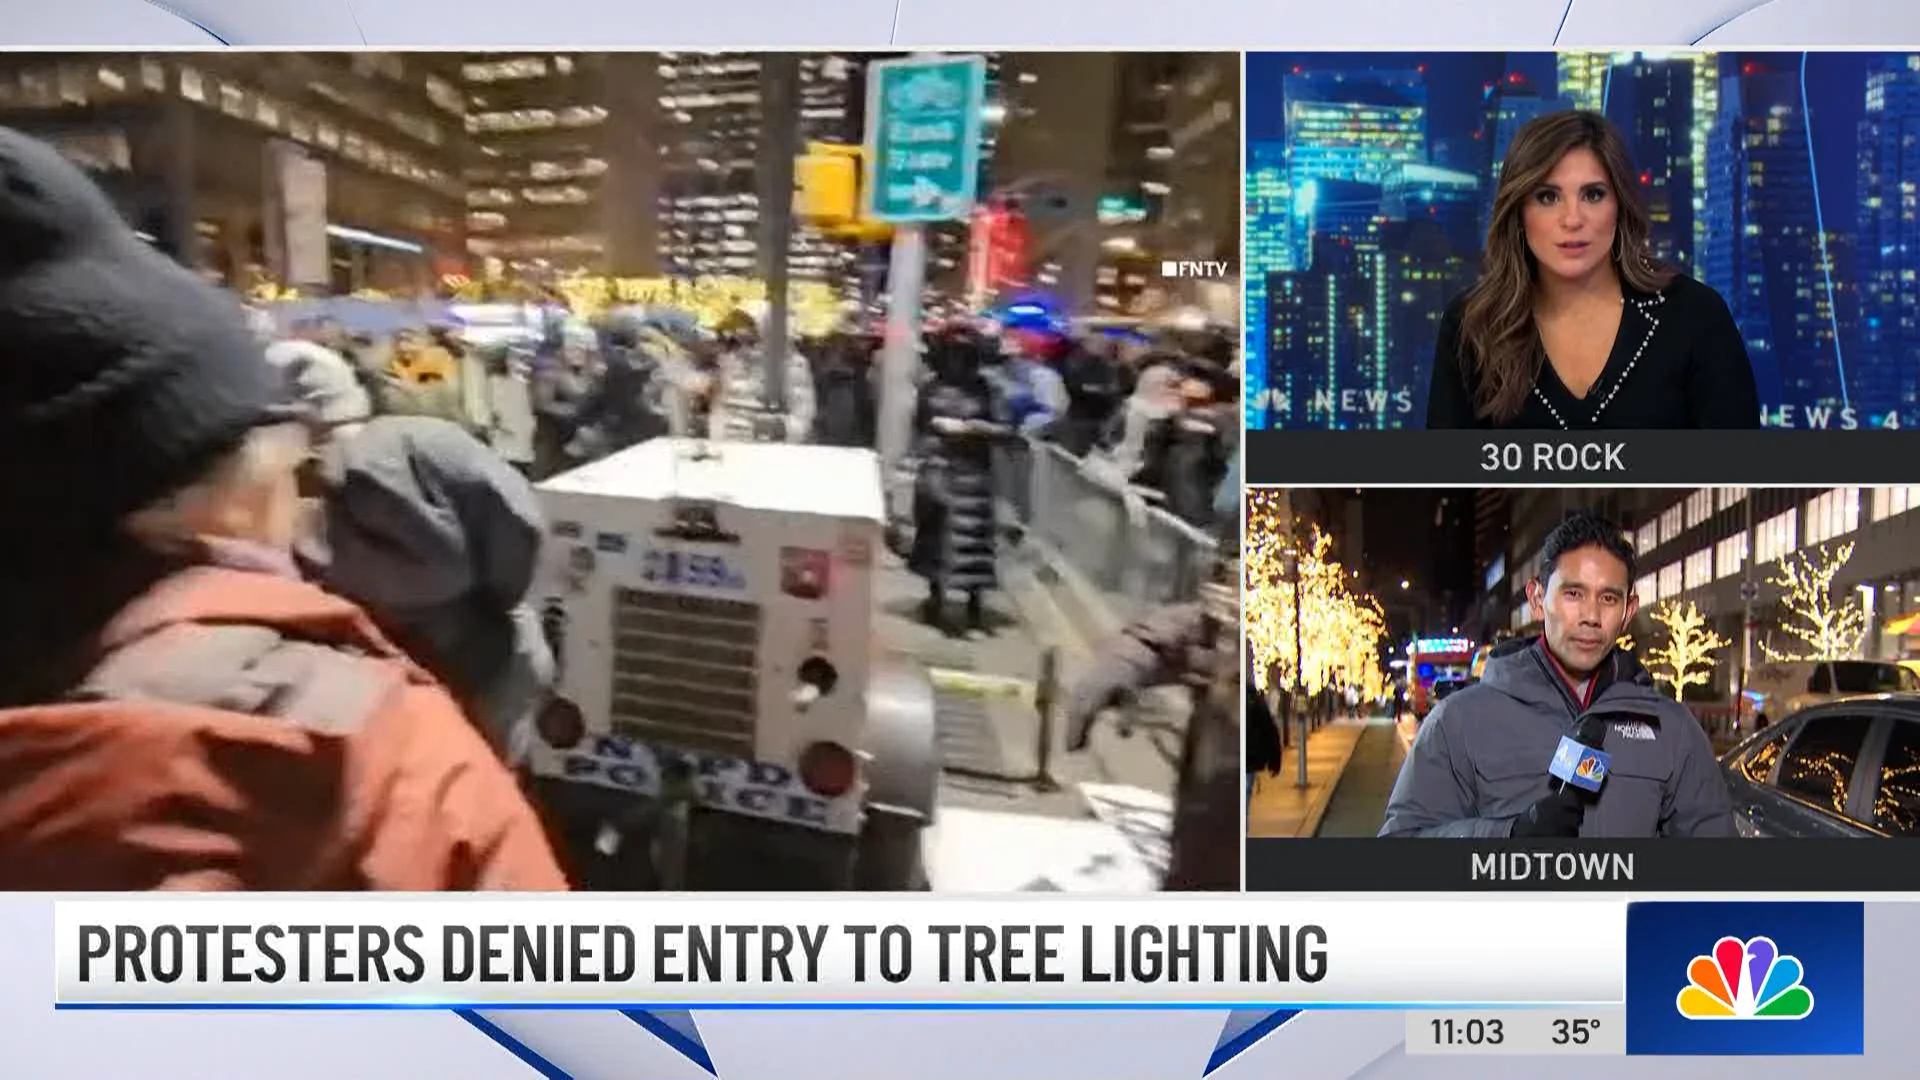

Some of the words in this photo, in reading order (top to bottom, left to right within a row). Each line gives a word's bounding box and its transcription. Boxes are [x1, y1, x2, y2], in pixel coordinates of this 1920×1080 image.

[1315, 388, 1412, 413] NEWS
[1882, 410, 1900, 430] 4
[595, 736, 793, 787] NPD
[565, 754, 829, 822] POICE
